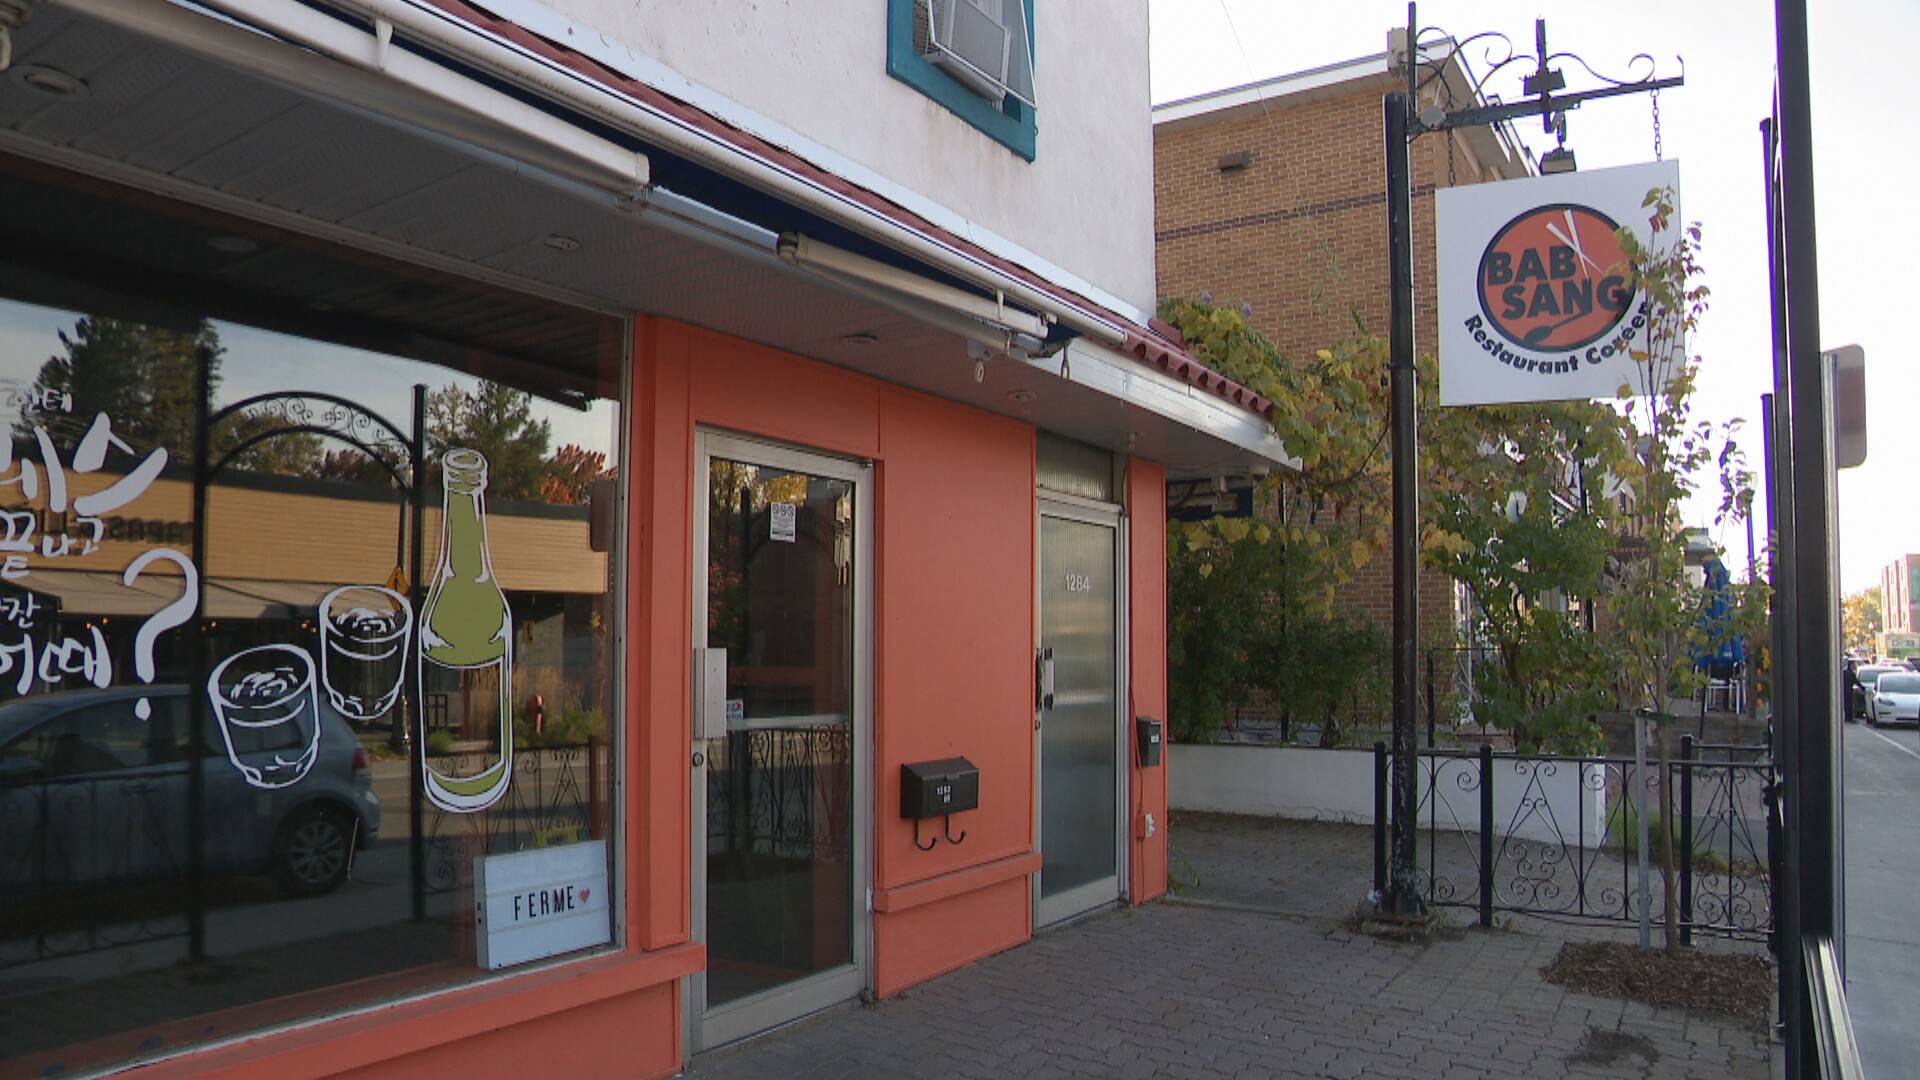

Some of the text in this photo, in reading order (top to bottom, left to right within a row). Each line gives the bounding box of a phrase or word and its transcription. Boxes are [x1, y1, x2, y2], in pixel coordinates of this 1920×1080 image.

[1488, 245, 1577, 286] BAB
[1502, 275, 1631, 320] SANG
[1464, 313, 1579, 374] Restaurant
[1065, 573, 1090, 593] 1284
[513, 885, 575, 921] FERME
